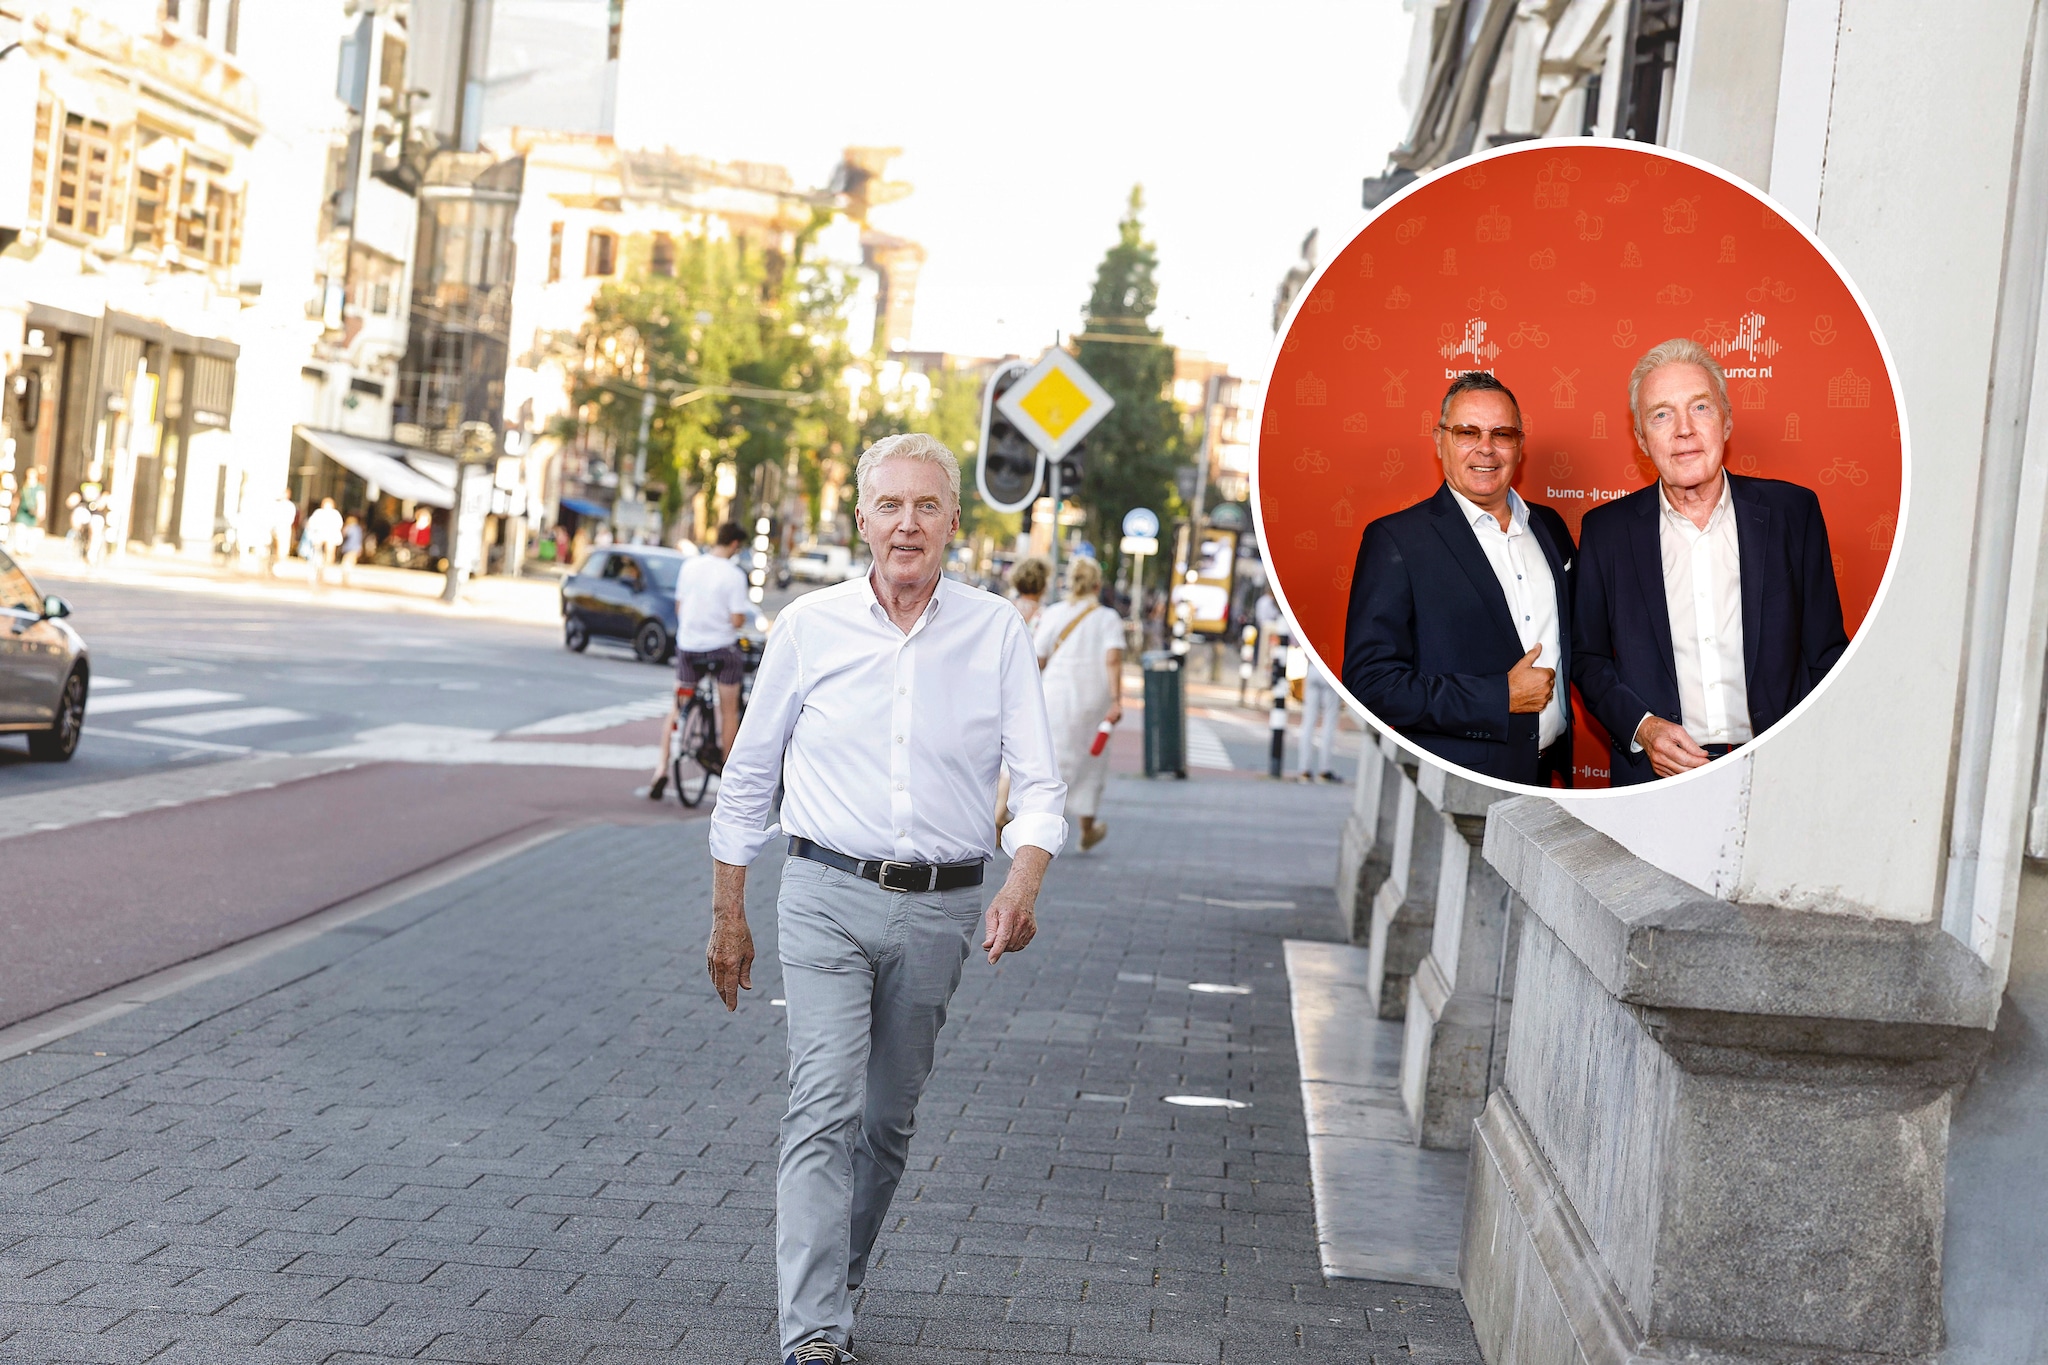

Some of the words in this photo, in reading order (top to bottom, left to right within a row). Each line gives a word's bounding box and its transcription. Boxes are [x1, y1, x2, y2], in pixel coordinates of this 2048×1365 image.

[1723, 367, 1757, 379] uma
[1759, 365, 1773, 379] nl
[1547, 485, 1585, 499] buma
